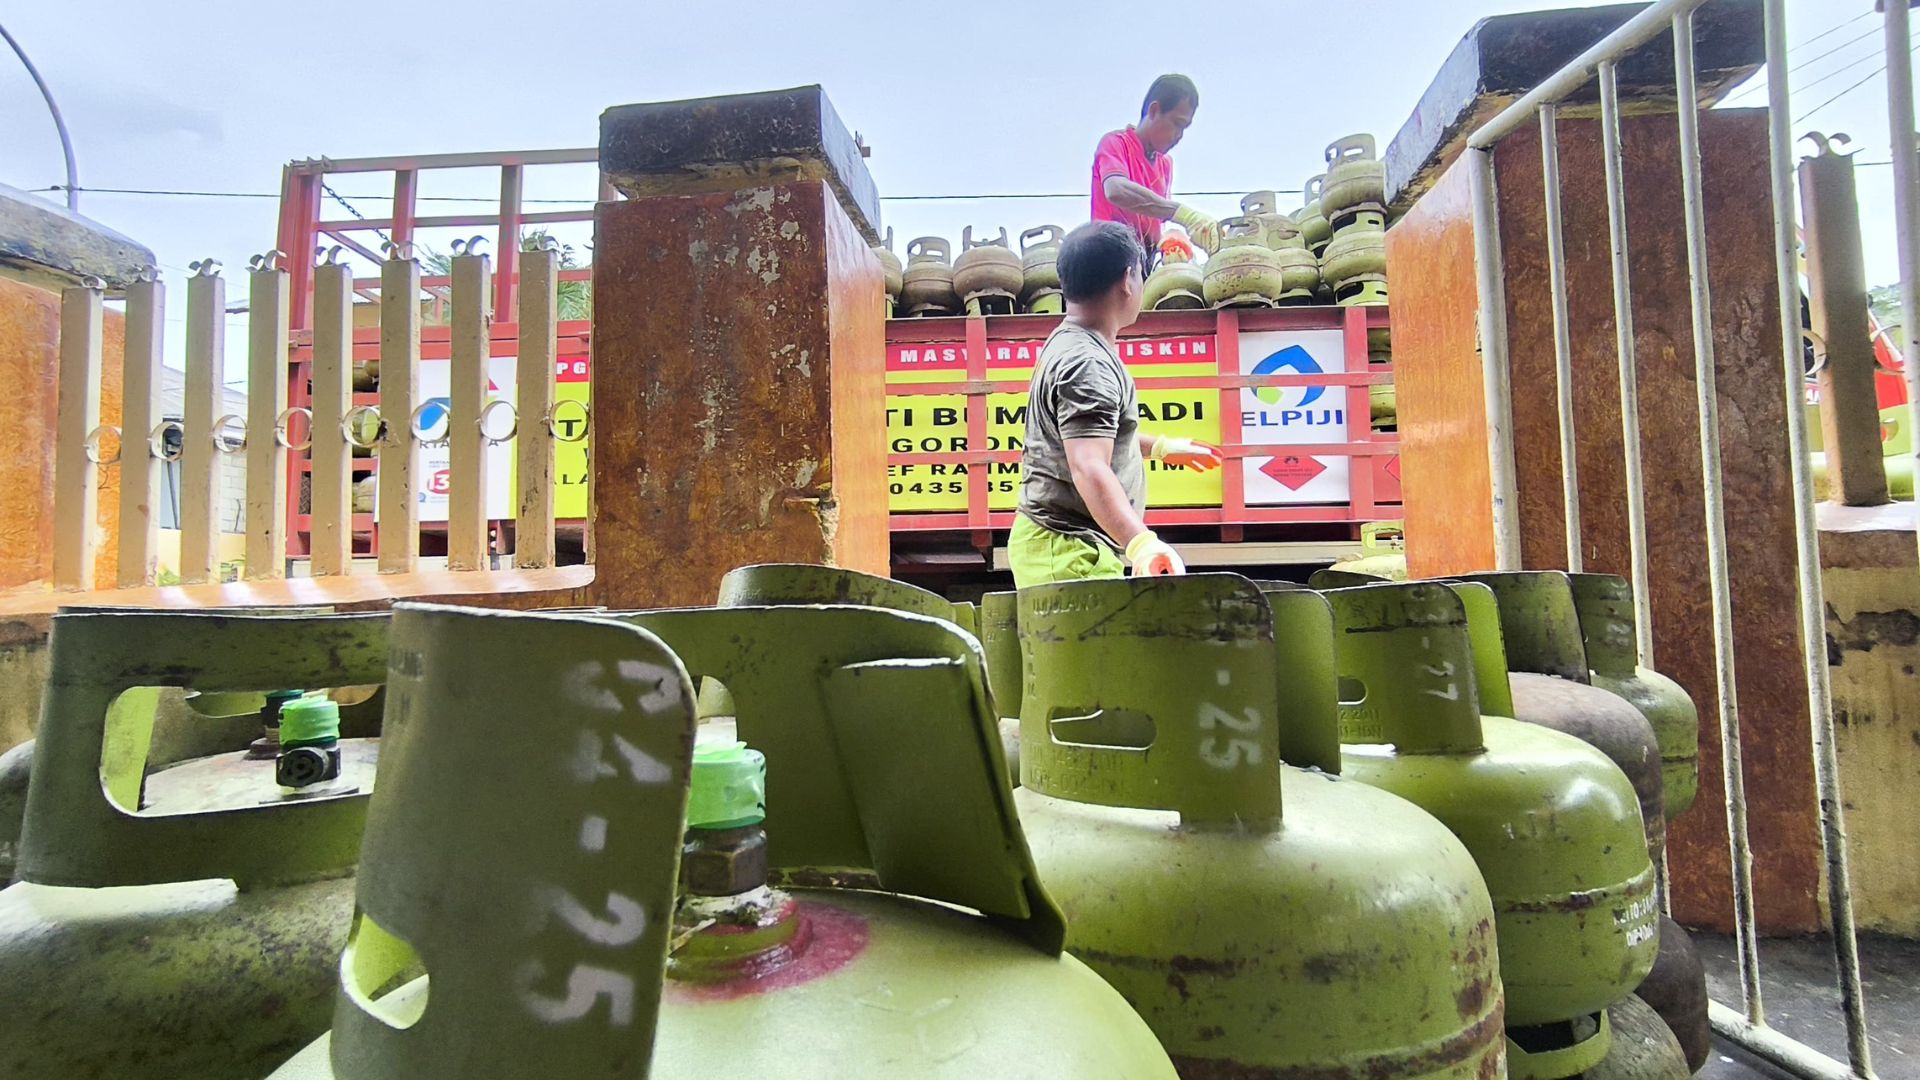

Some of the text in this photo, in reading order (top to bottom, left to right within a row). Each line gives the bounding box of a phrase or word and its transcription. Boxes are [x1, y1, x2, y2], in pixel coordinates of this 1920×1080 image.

[1115, 341, 1206, 357] ISKIN
[1242, 409, 1343, 427] ELPIJI
[889, 481, 963, 495] 0435
